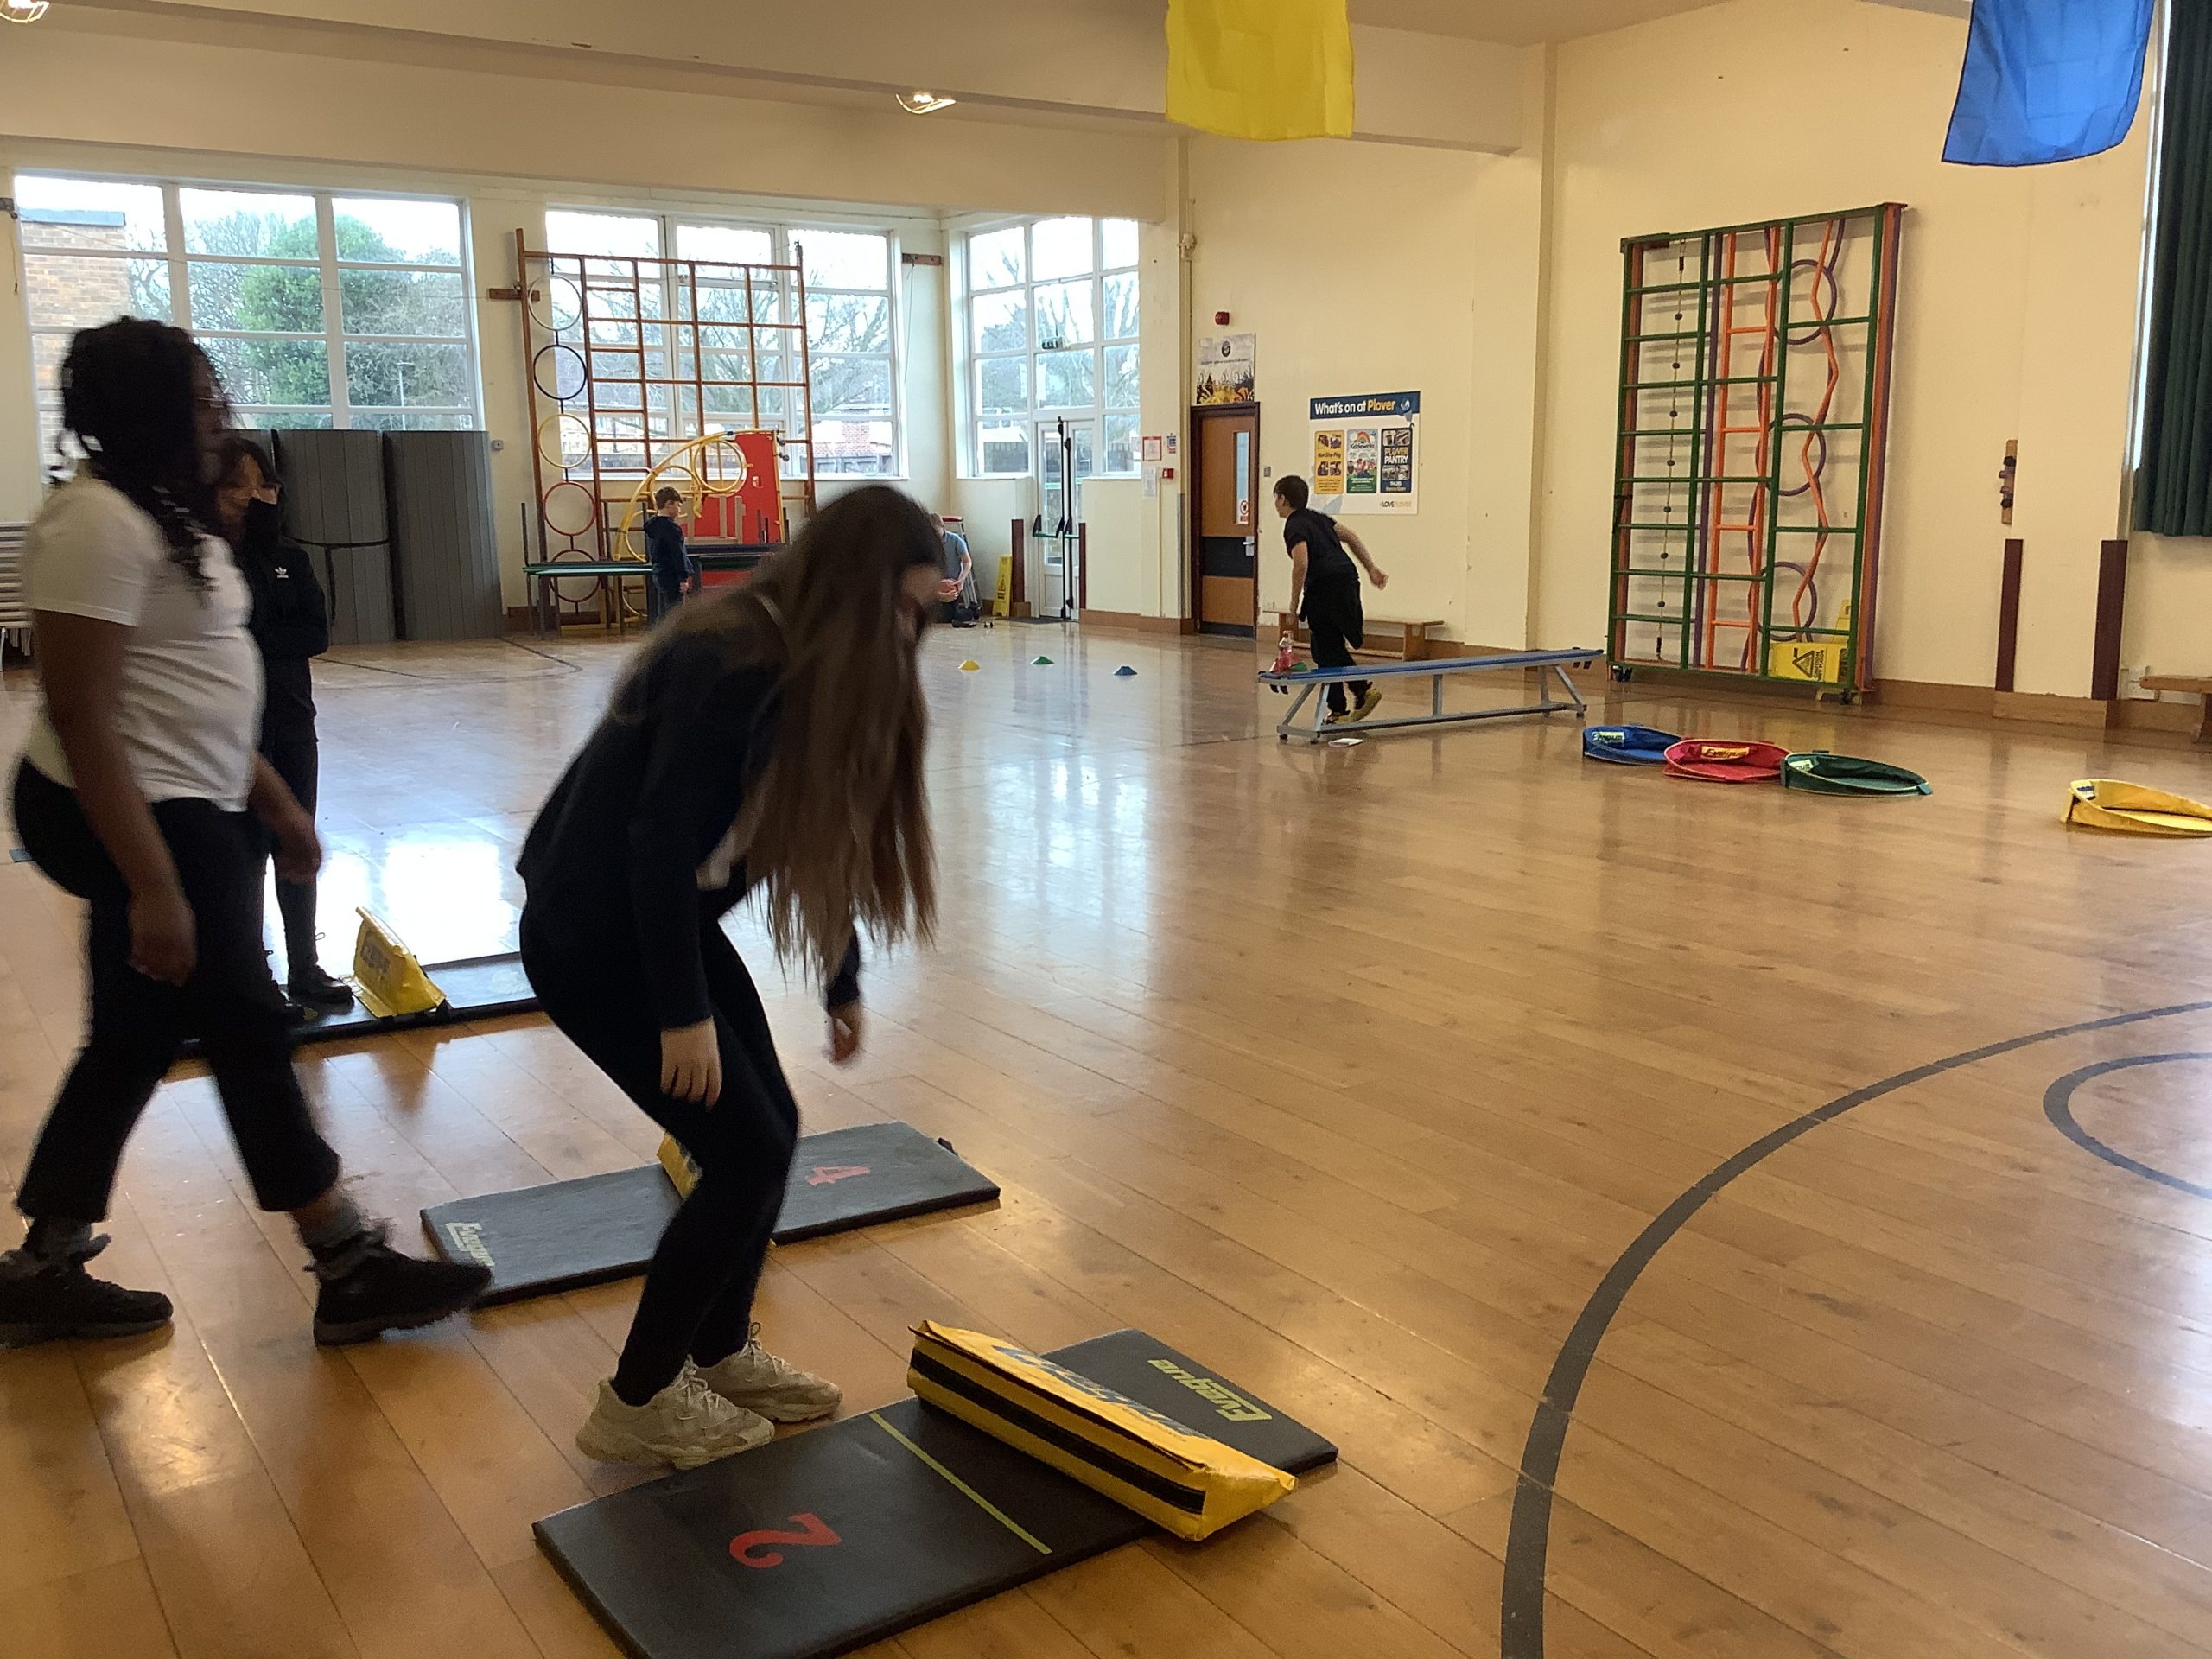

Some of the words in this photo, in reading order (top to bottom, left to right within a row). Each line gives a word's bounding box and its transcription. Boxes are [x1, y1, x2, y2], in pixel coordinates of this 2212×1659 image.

[1314, 401, 1344, 415] What's
[1344, 403, 1356, 413] on
[1357, 400, 1366, 412] at
[1367, 398, 1396, 412] Plover
[1384, 455, 1409, 465] PANTRY
[804, 1165, 871, 1186] 4
[728, 1512, 843, 1568] 2
